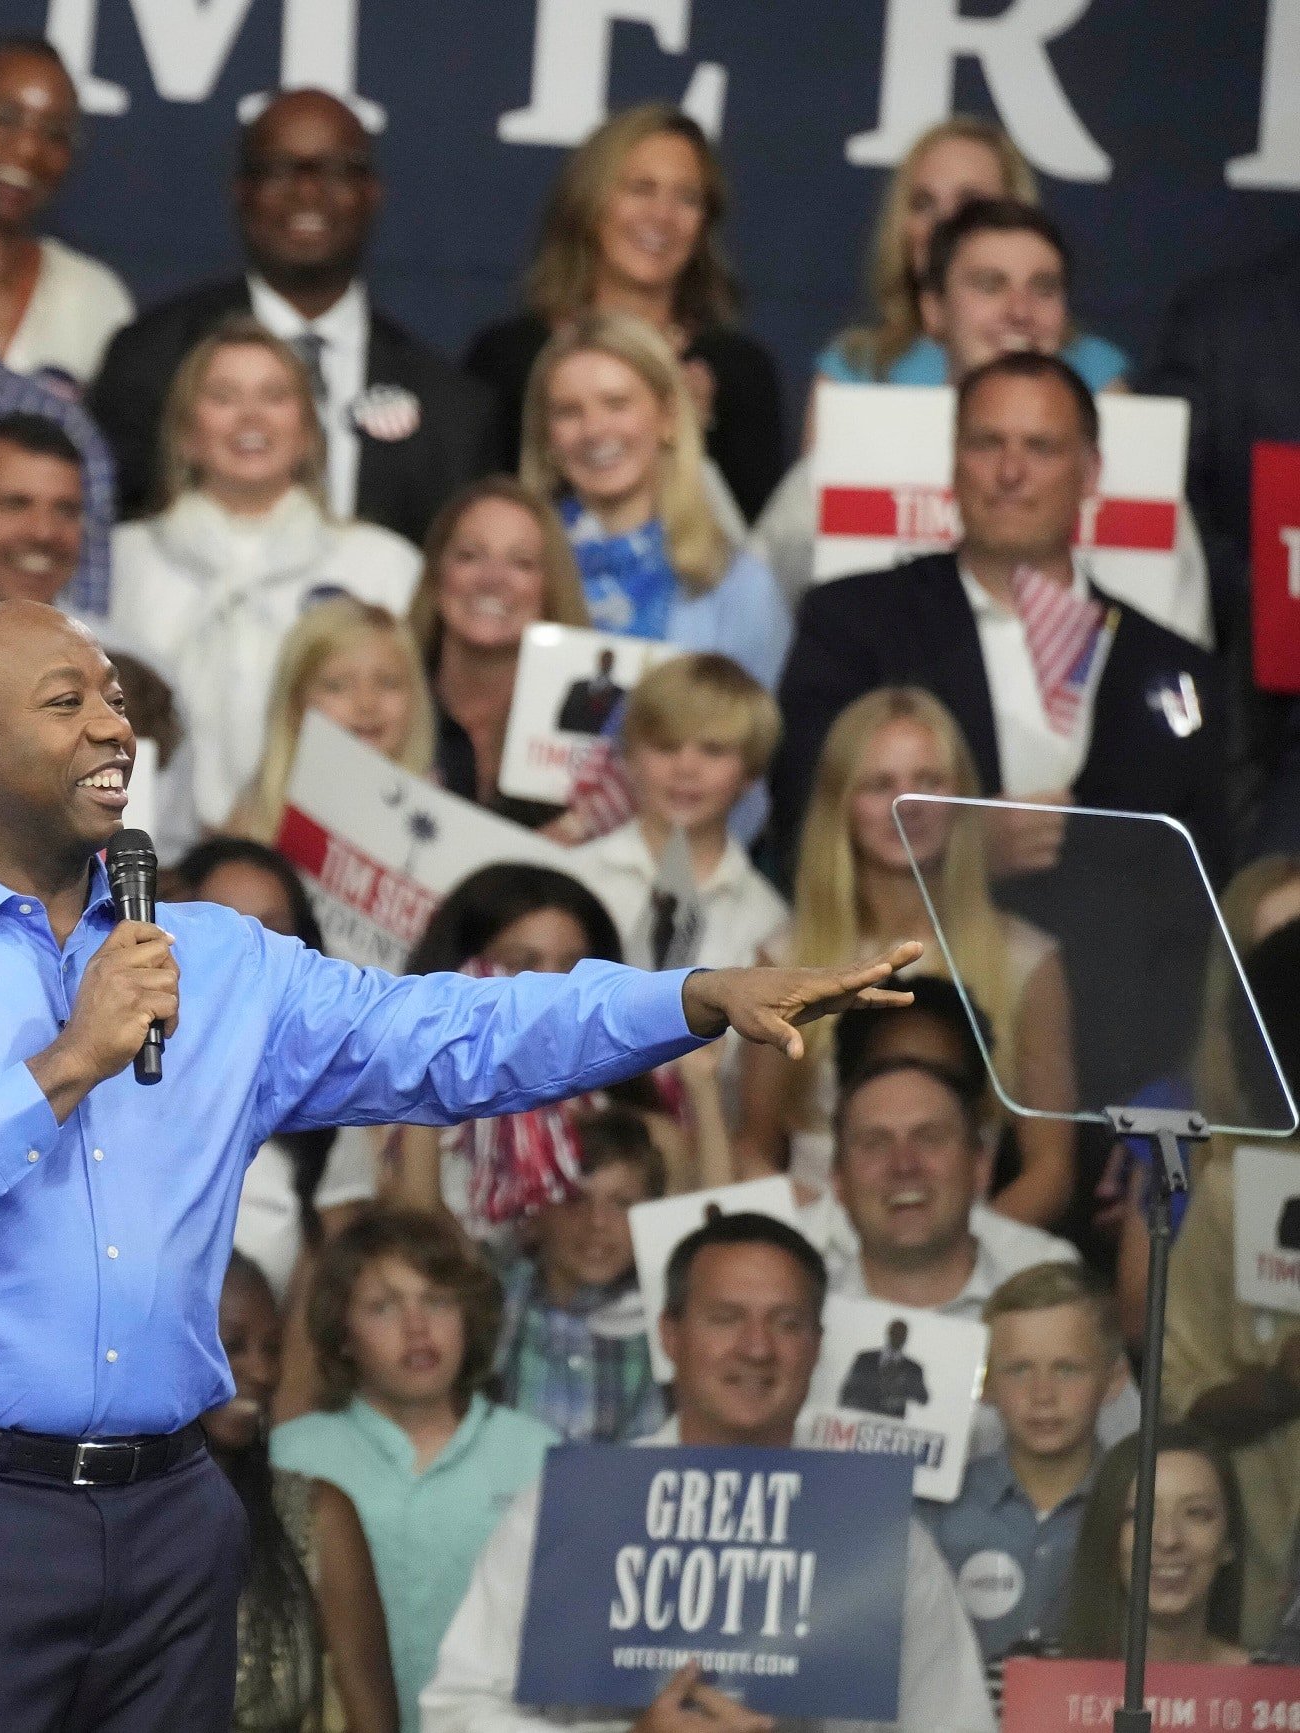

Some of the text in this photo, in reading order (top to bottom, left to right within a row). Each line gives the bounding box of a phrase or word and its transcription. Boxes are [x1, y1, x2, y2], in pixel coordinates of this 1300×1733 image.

[646, 1468, 803, 1544] GREAT
[608, 1545, 818, 1638] SCOTT!
[1068, 1695, 1125, 1726] TEX
[1145, 1696, 1197, 1728] TIM
[1208, 1699, 1244, 1730] TO
